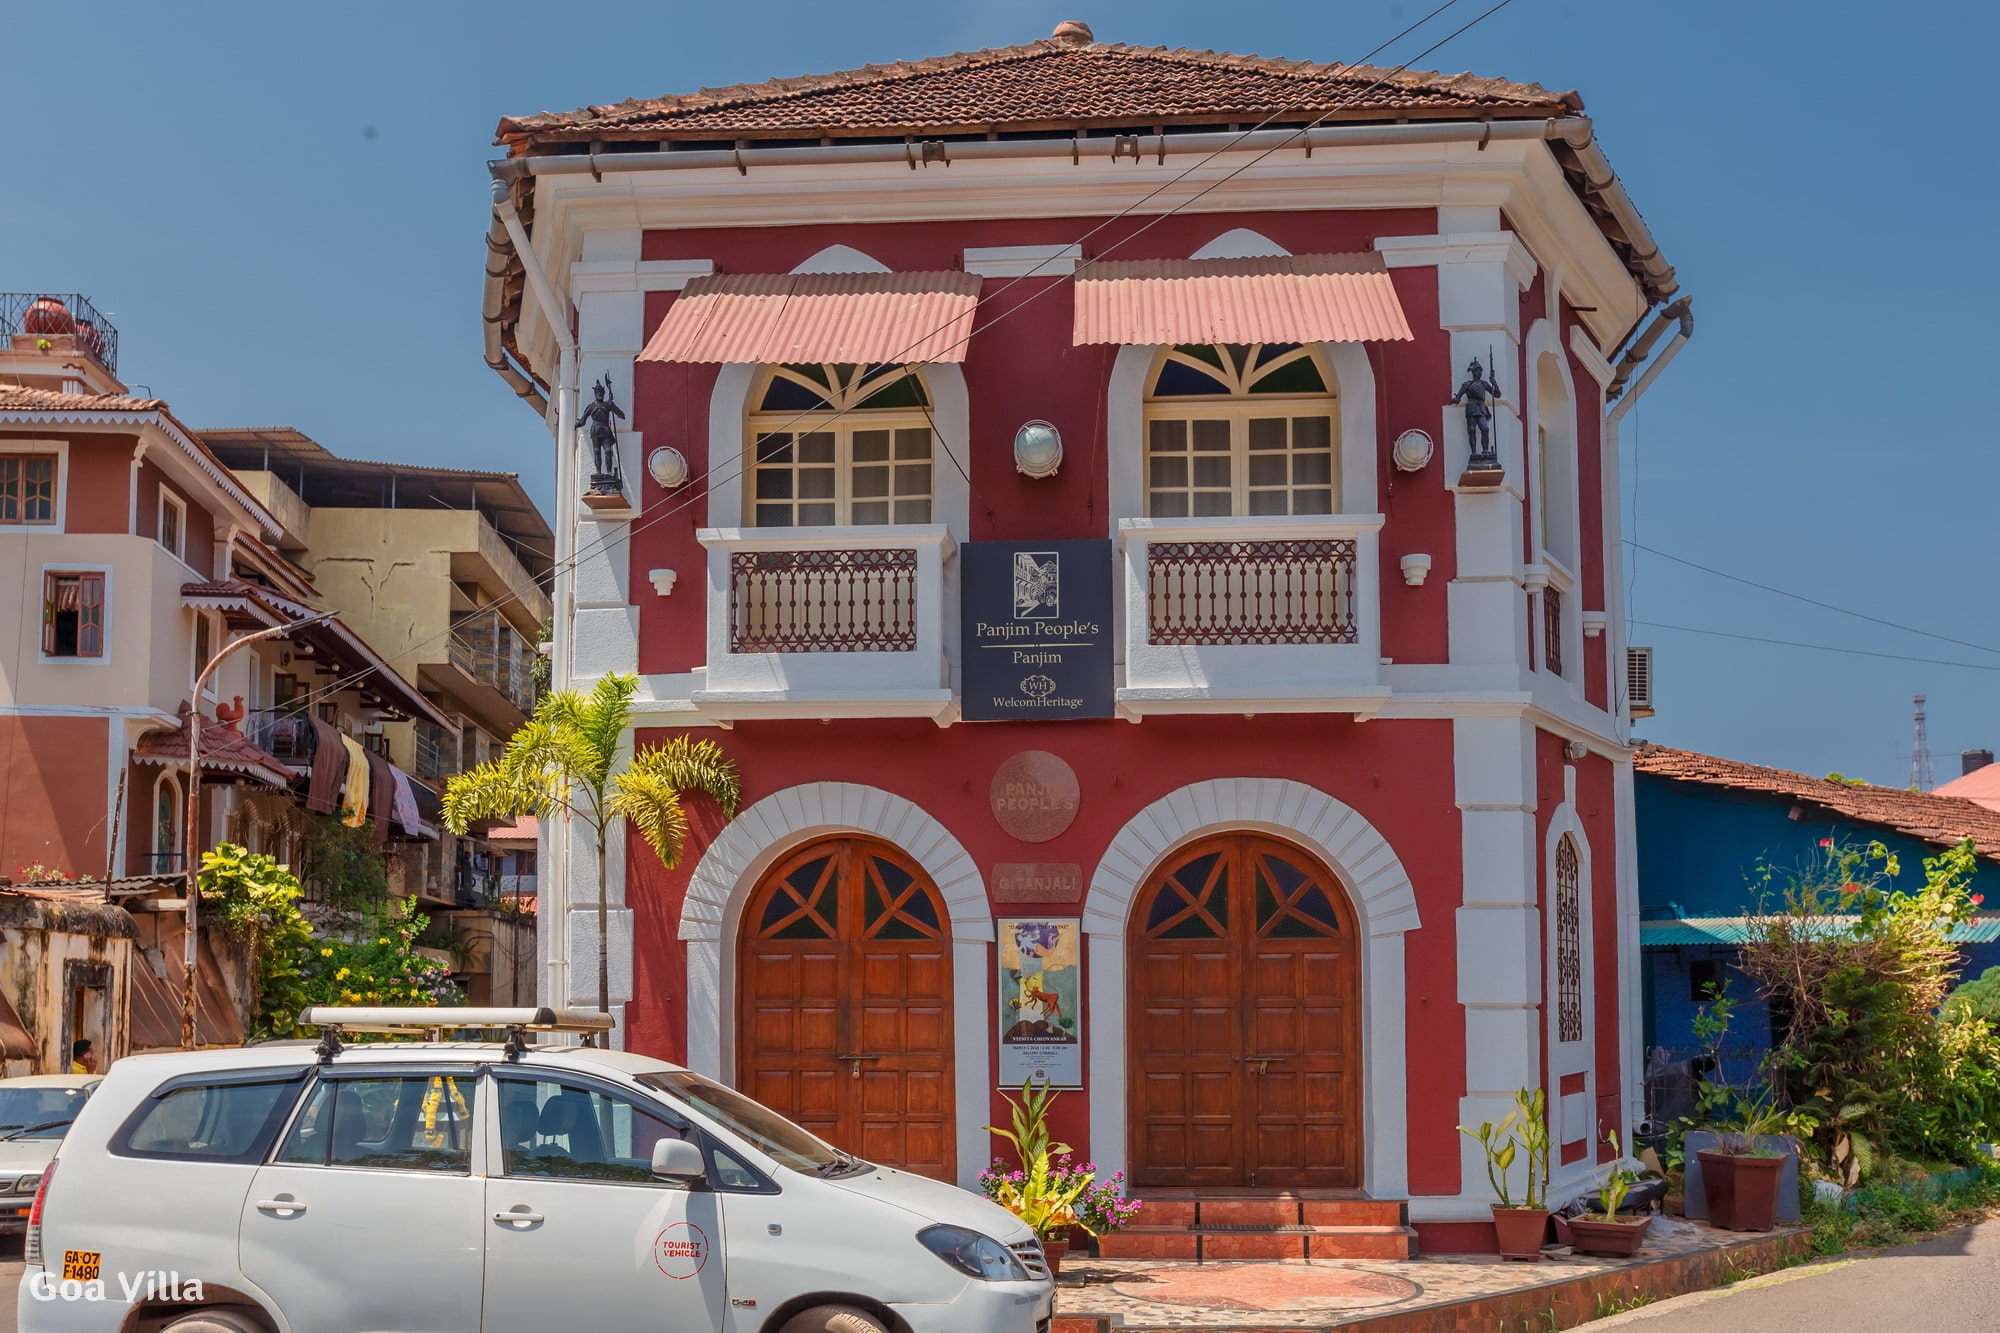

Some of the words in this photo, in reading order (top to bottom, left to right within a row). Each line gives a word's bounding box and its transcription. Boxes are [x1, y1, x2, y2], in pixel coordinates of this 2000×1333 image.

[976, 622, 1030, 640] Panjim
[1034, 620, 1099, 639] People's
[1013, 651, 1062, 668] Panjim
[1029, 682, 1047, 690] WH
[993, 697, 1083, 709] WelcomHeritage
[663, 1241, 701, 1249] TOURIST
